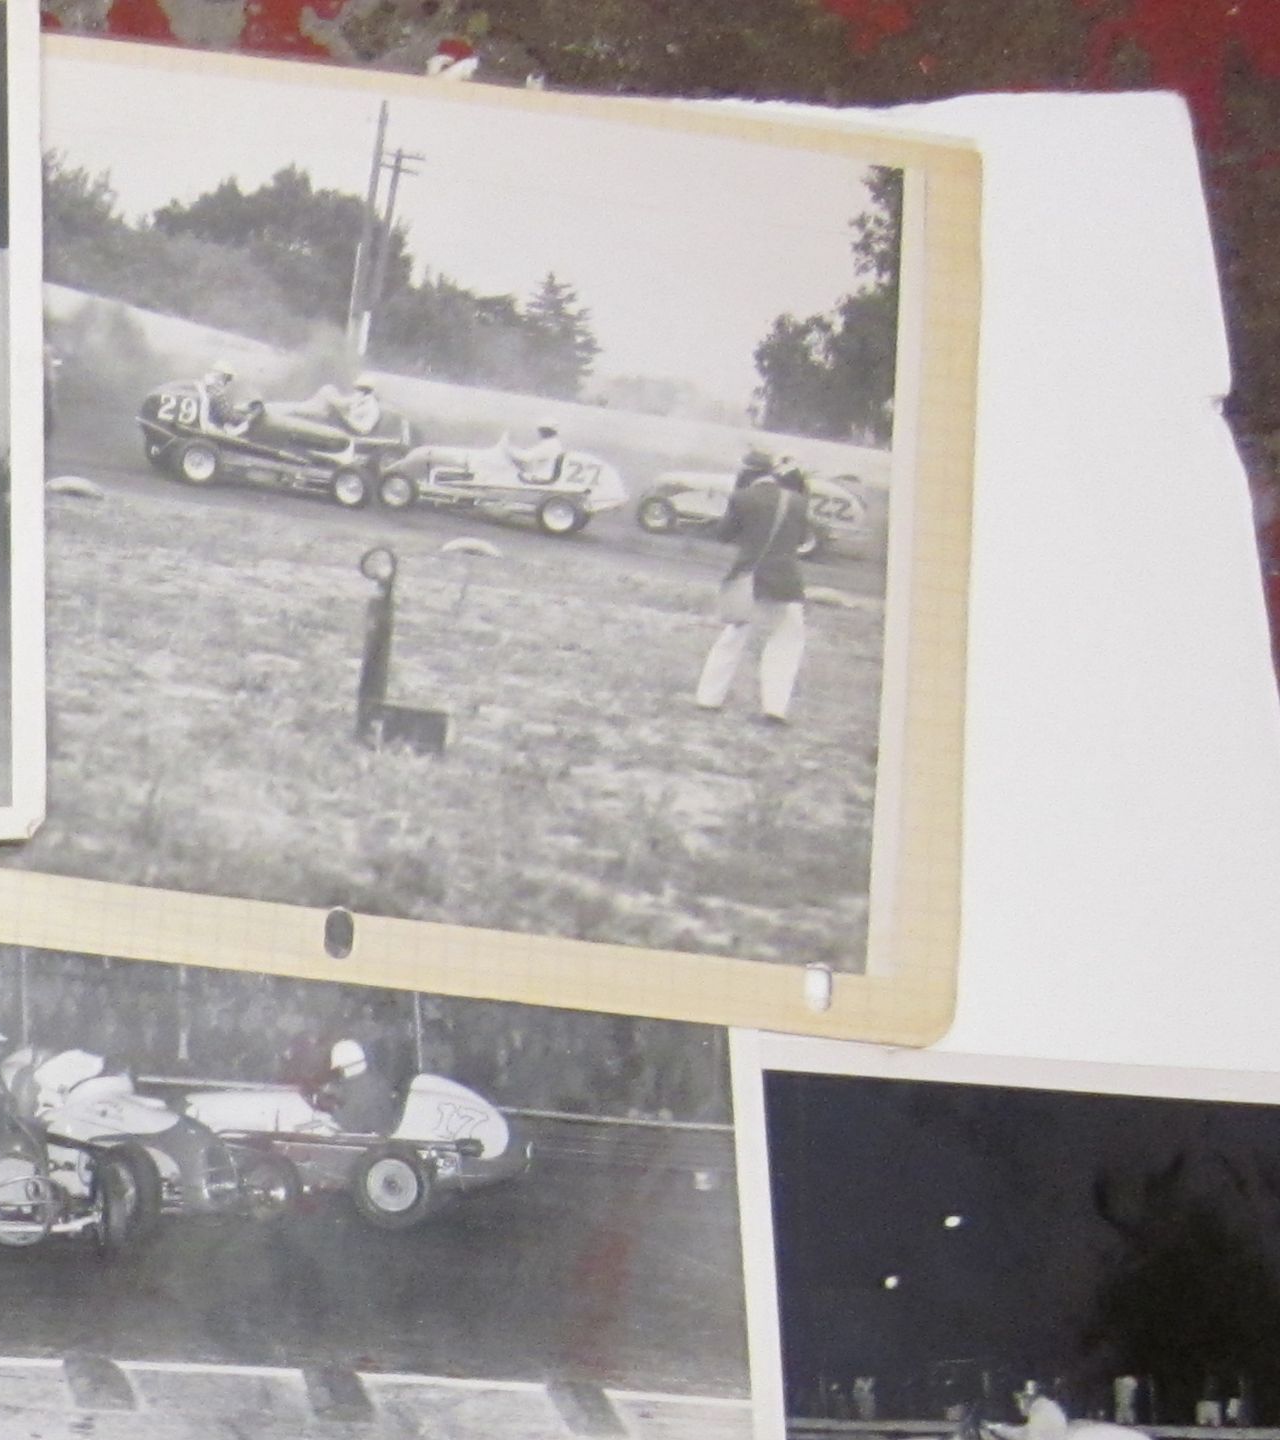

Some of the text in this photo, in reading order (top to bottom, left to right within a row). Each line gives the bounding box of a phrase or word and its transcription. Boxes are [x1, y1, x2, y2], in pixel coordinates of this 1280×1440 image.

[158, 394, 197, 425] 29
[566, 460, 601, 486] 27
[433, 1102, 490, 1140] 17
